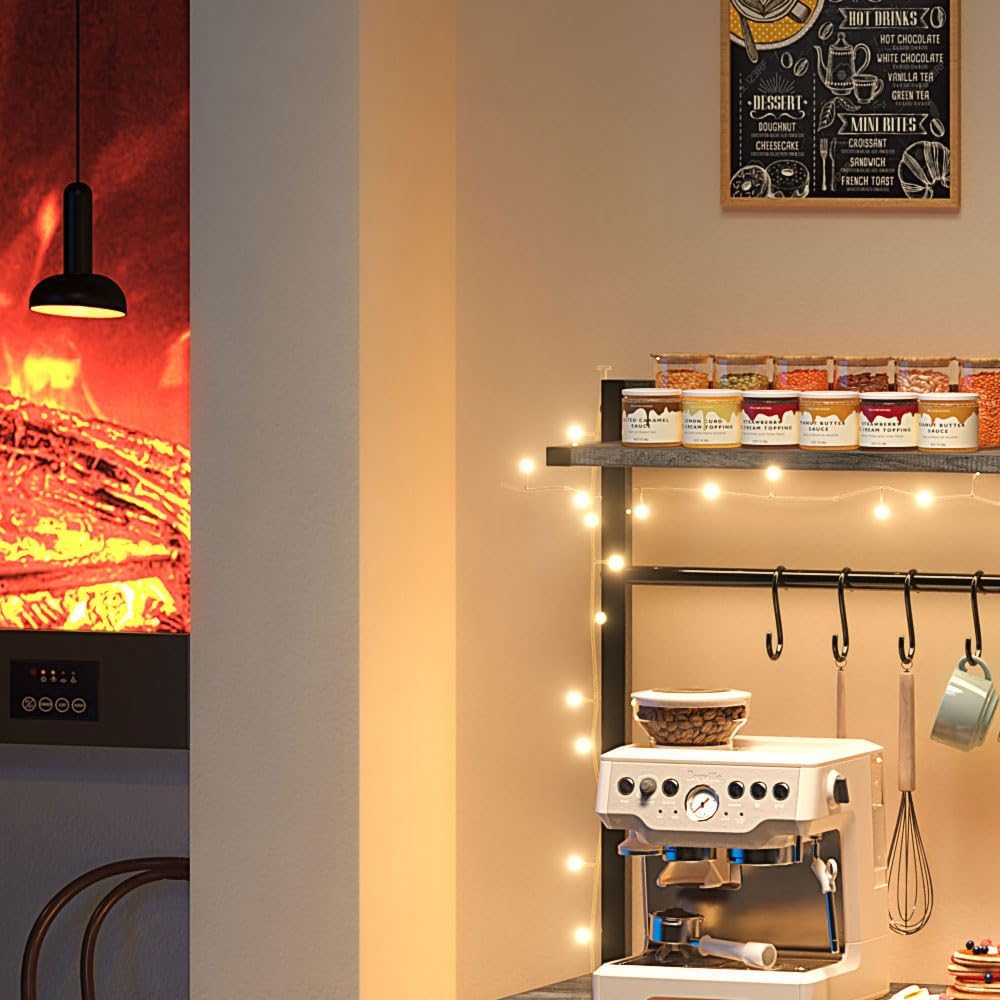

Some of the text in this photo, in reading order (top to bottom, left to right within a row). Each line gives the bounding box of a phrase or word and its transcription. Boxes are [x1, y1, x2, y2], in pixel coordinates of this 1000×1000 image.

[848, 10, 918, 26] HOT DRINKS
[880, 34, 940, 44] HOT CHOCOLATE
[877, 53, 944, 63] WHITE CHOCOLATE
[888, 72, 934, 82] VANILLA TEA
[891, 91, 930, 101] GREEN TEA
[753, 95, 803, 111] DESSERT
[758, 122, 797, 132] DOUGHNUT
[851, 116, 917, 132] MINI BITES
[755, 141, 800, 151] CHEESECAKE
[848, 138, 887, 148] CROISSANT
[849, 157, 886, 167] SANDWICH
[841, 176, 894, 186] FRENCH TOAST
